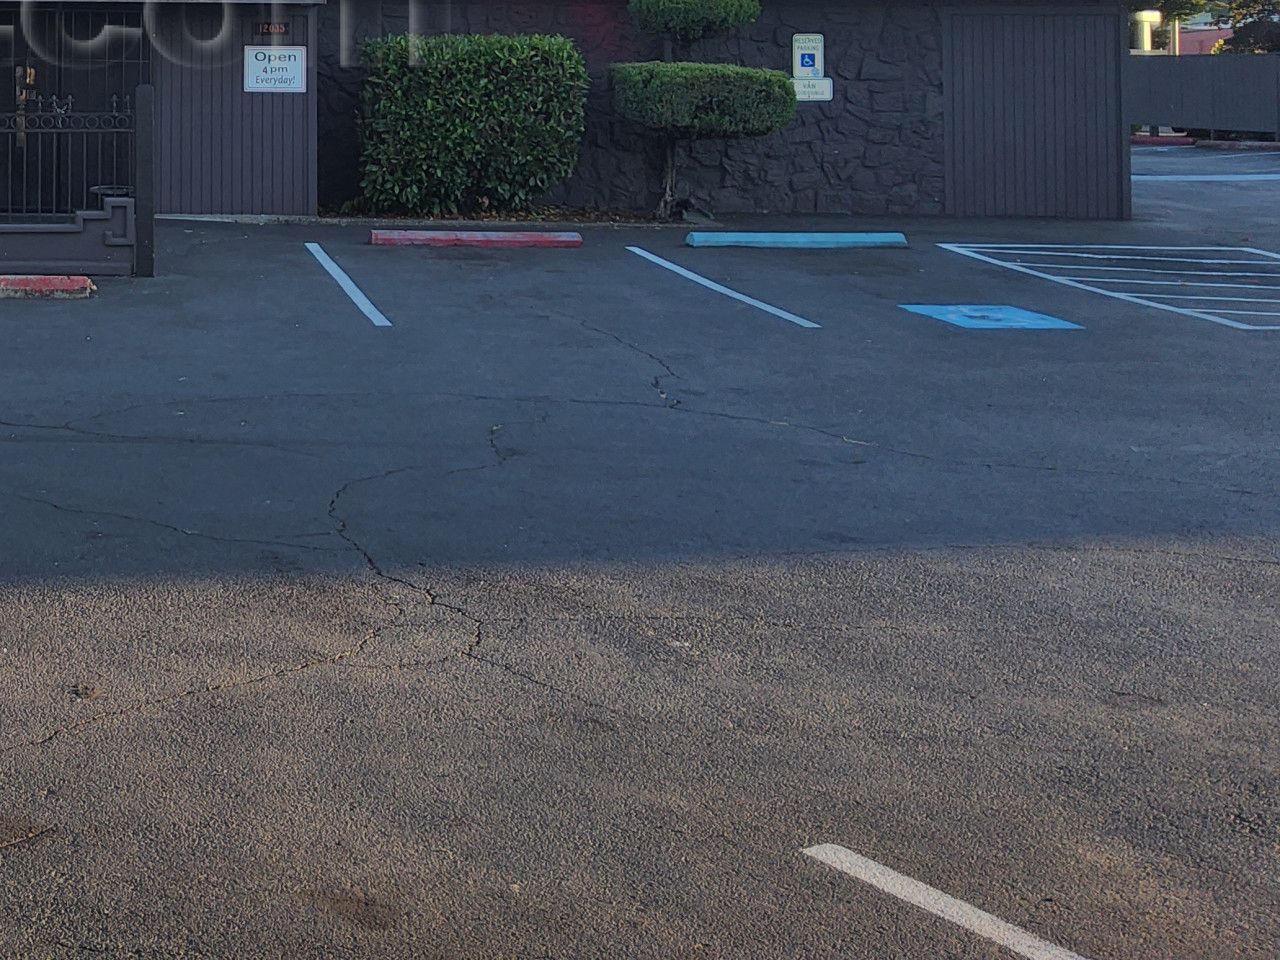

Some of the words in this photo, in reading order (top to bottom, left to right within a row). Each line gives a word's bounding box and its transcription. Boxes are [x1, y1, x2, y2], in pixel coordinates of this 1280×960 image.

[254, 51, 297, 64] Open
[262, 66, 268, 74] 4
[270, 66, 288, 74] pm
[255, 75, 296, 86] Everyday!
